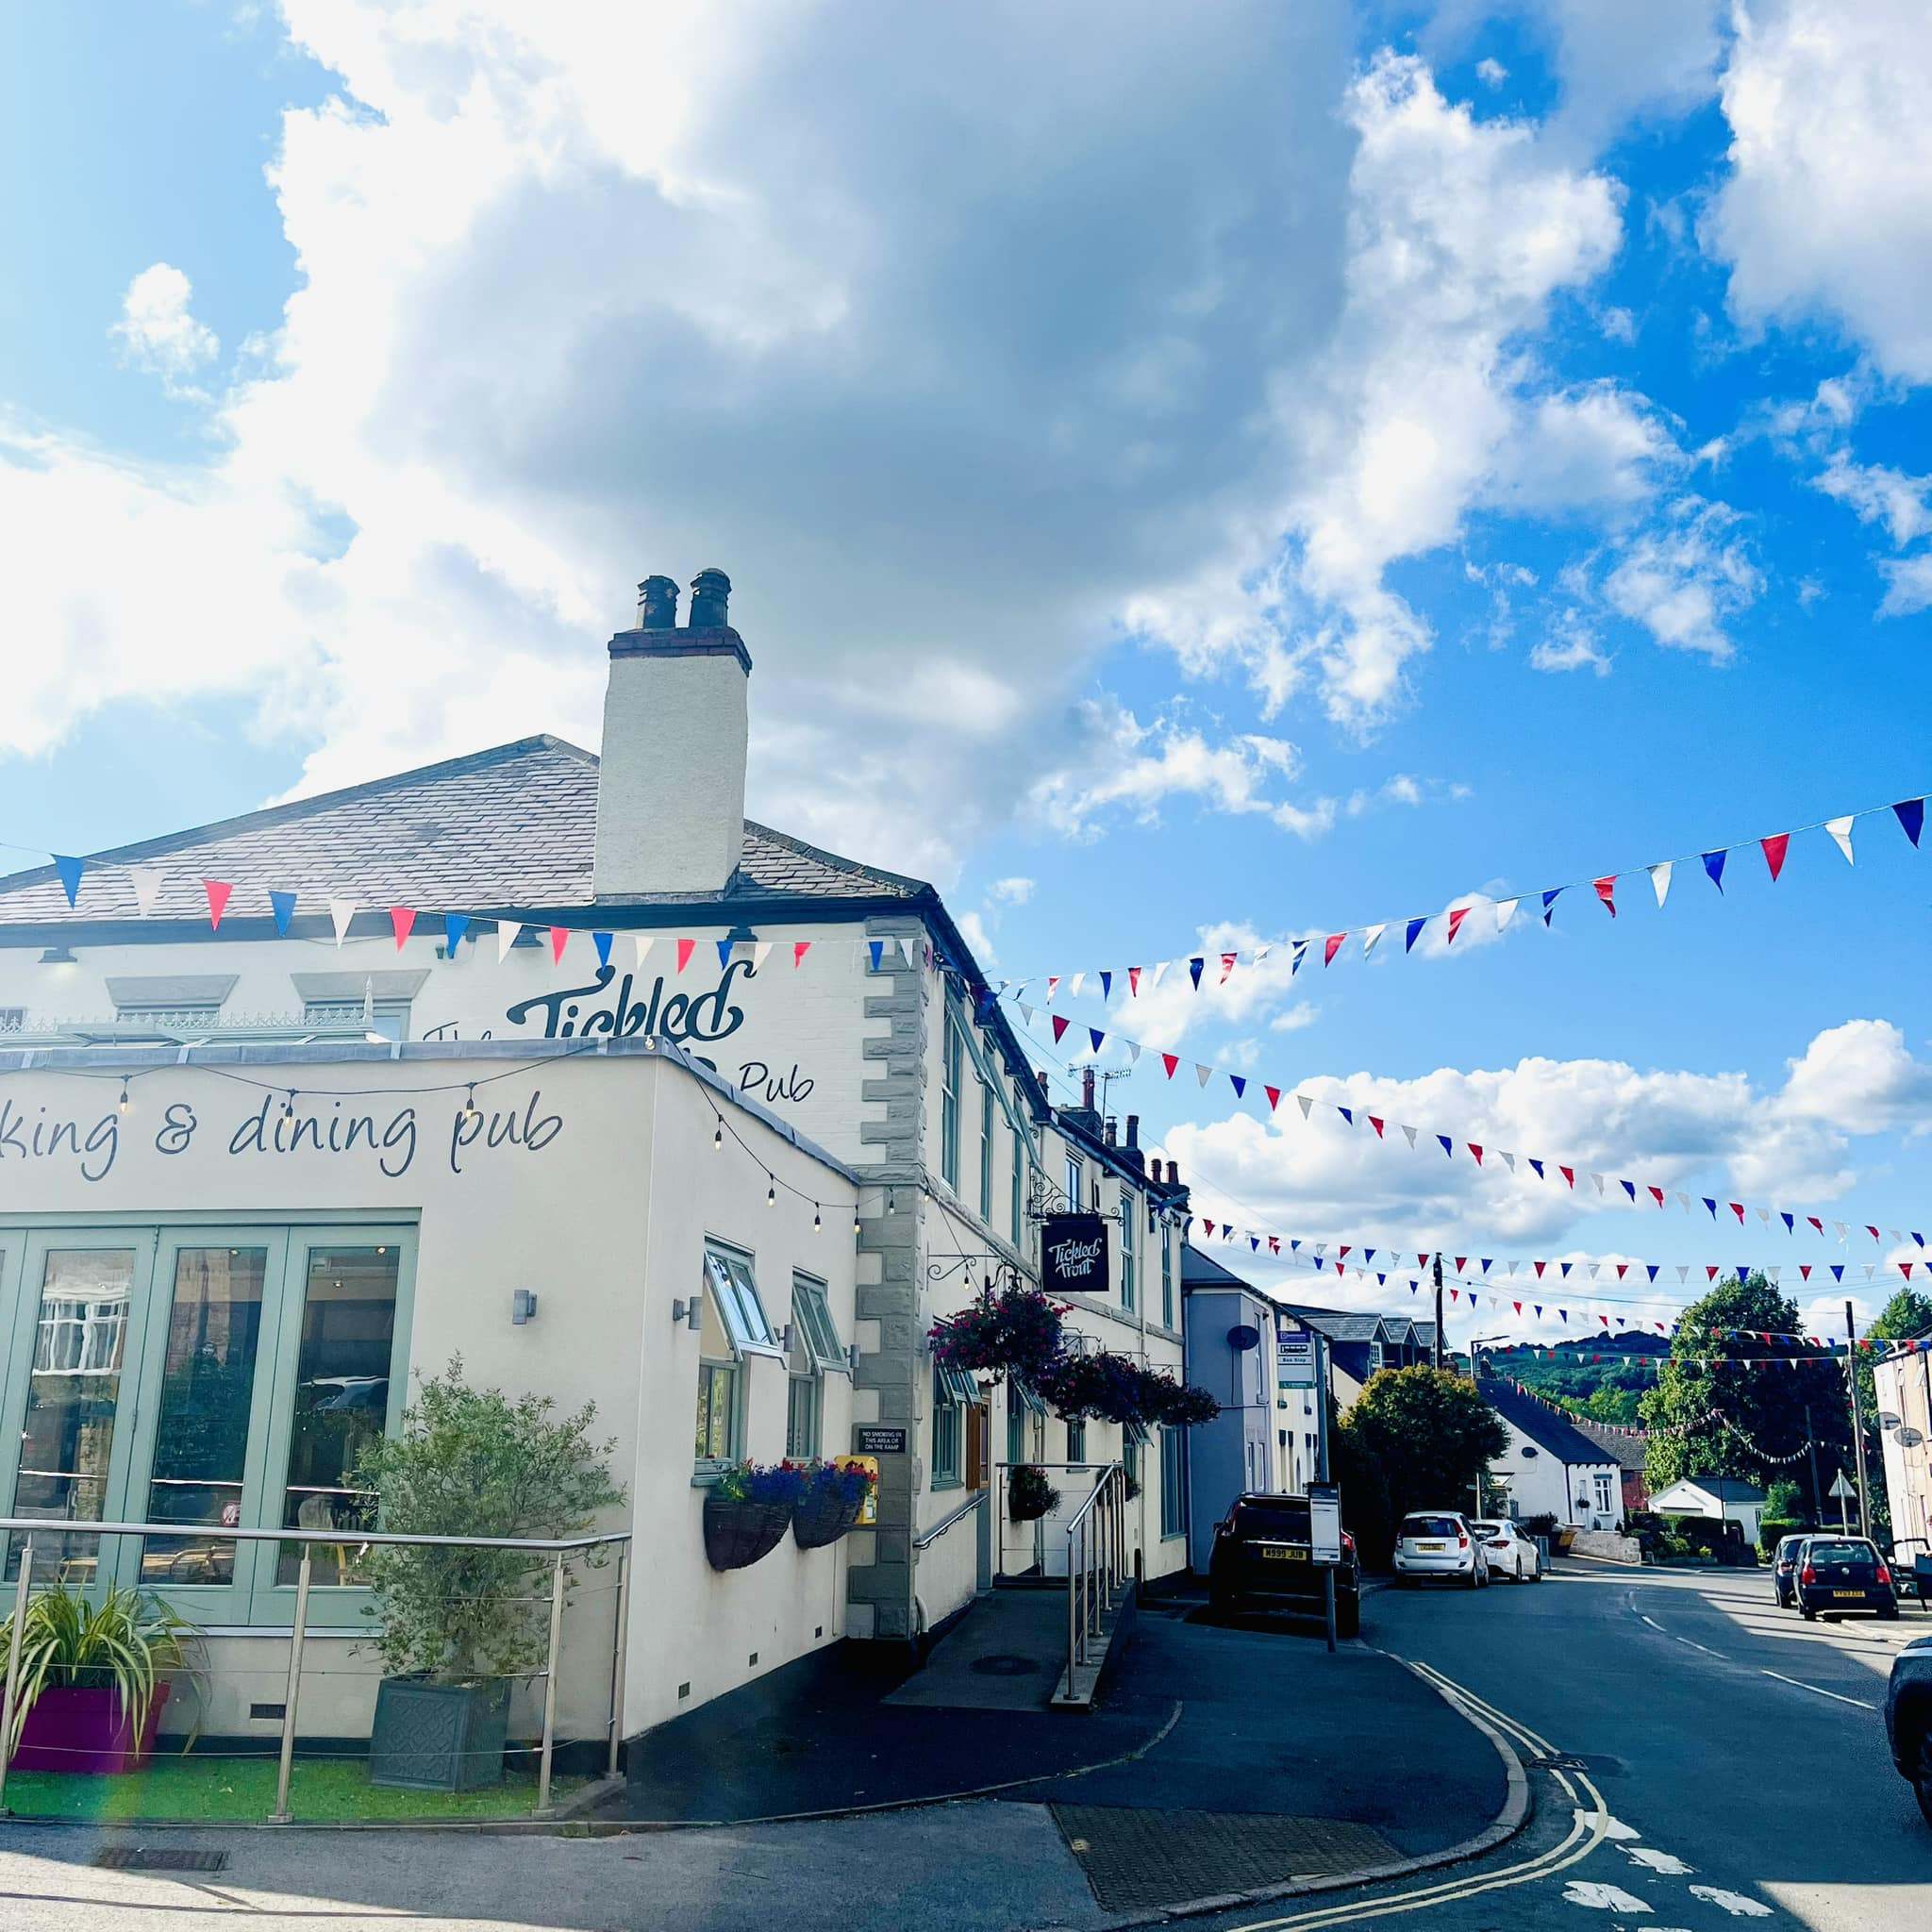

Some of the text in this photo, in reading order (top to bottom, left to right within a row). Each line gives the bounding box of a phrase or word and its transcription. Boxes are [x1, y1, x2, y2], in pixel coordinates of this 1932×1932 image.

[739, 1062, 815, 1103] Pub
[155, 1104, 197, 1155] &
[228, 1093, 416, 1177] dining
[451, 1091, 563, 1174] pub
[1048, 1238, 1102, 1264] Tickled
